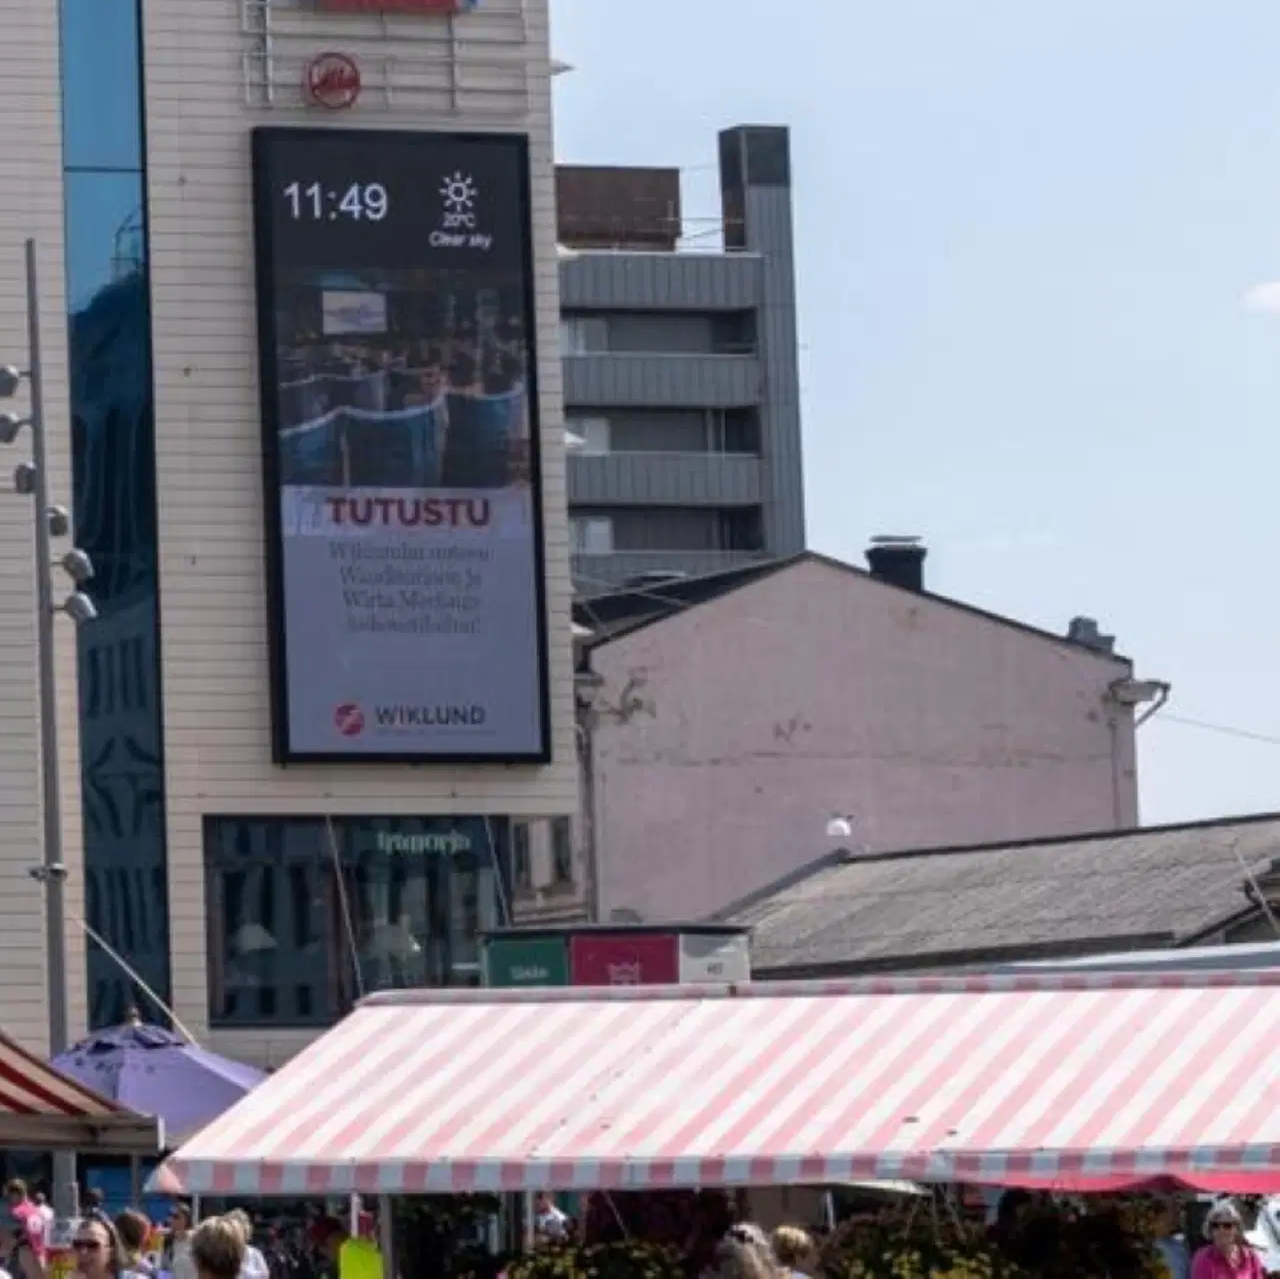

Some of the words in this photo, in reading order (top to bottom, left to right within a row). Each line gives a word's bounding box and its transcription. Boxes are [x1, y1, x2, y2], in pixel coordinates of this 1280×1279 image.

[283, 182, 388, 220] 11:49
[428, 231, 466, 248] Clear
[468, 232, 493, 252] sky
[326, 497, 490, 526] TUTUSTU
[374, 705, 487, 726] WIKLUND
